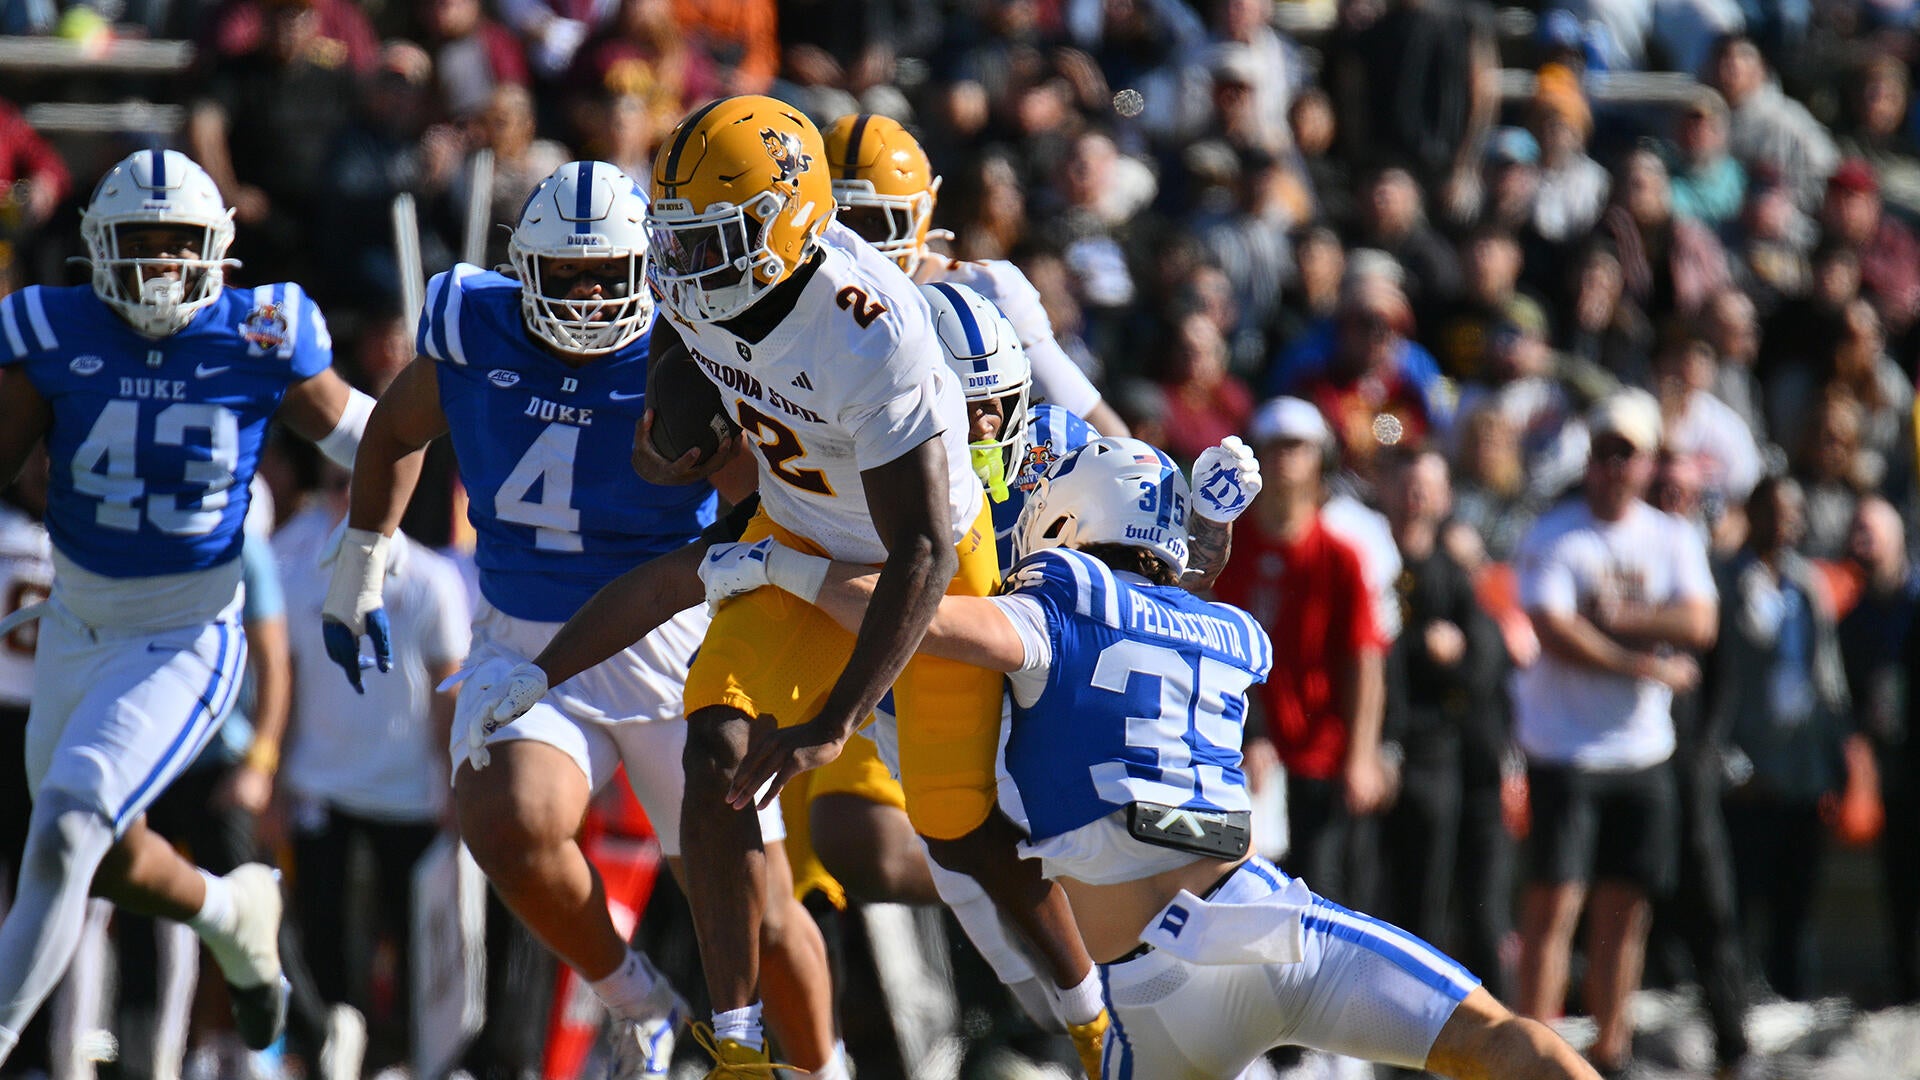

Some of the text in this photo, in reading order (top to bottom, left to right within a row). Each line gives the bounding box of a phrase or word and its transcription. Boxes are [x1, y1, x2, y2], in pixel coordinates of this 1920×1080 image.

[836, 285, 888, 330] 2
[119, 377, 187, 400] DUKE
[561, 377, 578, 392] D
[968, 374, 999, 388] DUKE
[524, 396, 593, 425] DUKE
[71, 399, 239, 535] 43
[736, 397, 838, 497] 2
[495, 422, 584, 552] 4
[1125, 524, 1162, 543] bull
[1128, 588, 1247, 661] PELLICCIOTTA
[1089, 638, 1254, 812] 35
[1158, 903, 1190, 939] D
